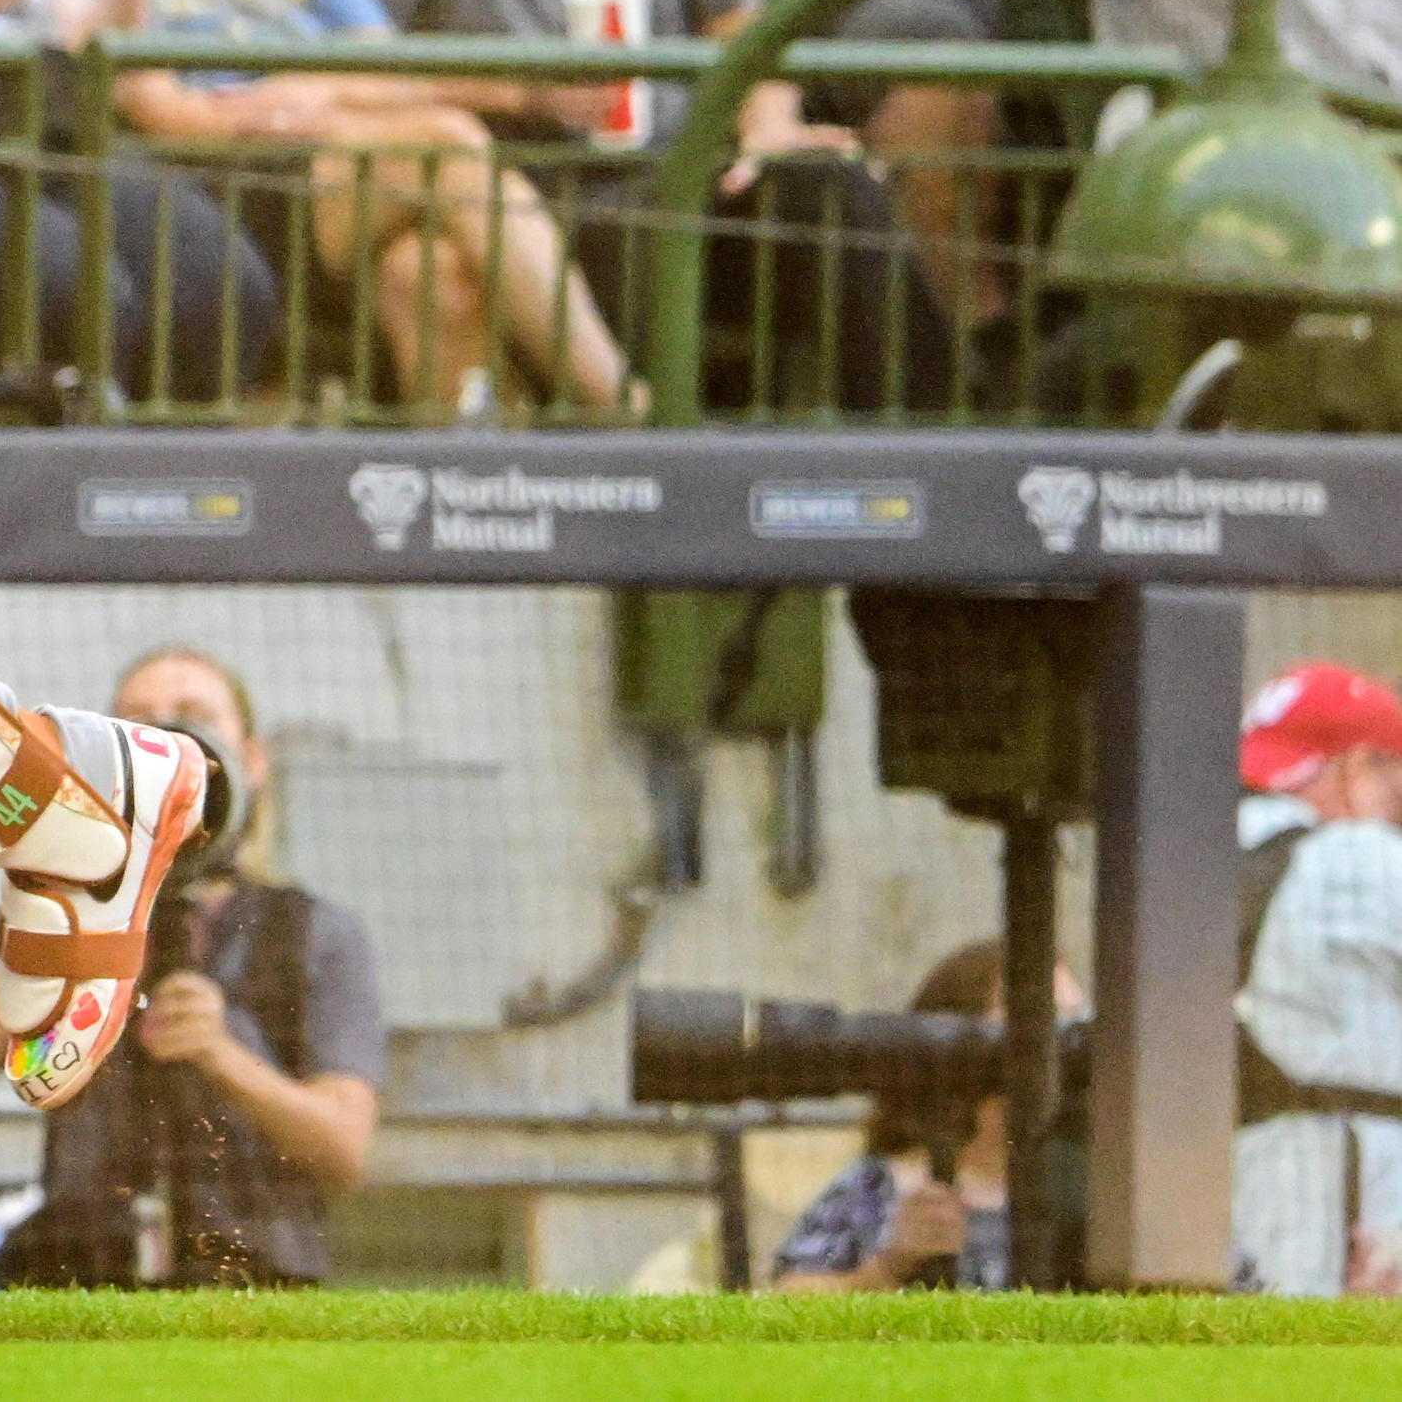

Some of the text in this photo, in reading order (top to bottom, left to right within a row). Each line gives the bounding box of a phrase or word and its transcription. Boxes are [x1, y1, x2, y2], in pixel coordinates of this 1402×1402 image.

[431, 466, 663, 512] Northwestern
[1099, 469, 1328, 517] Northwestern
[431, 509, 554, 551] Mutual
[1099, 506, 1222, 555] Mutual
